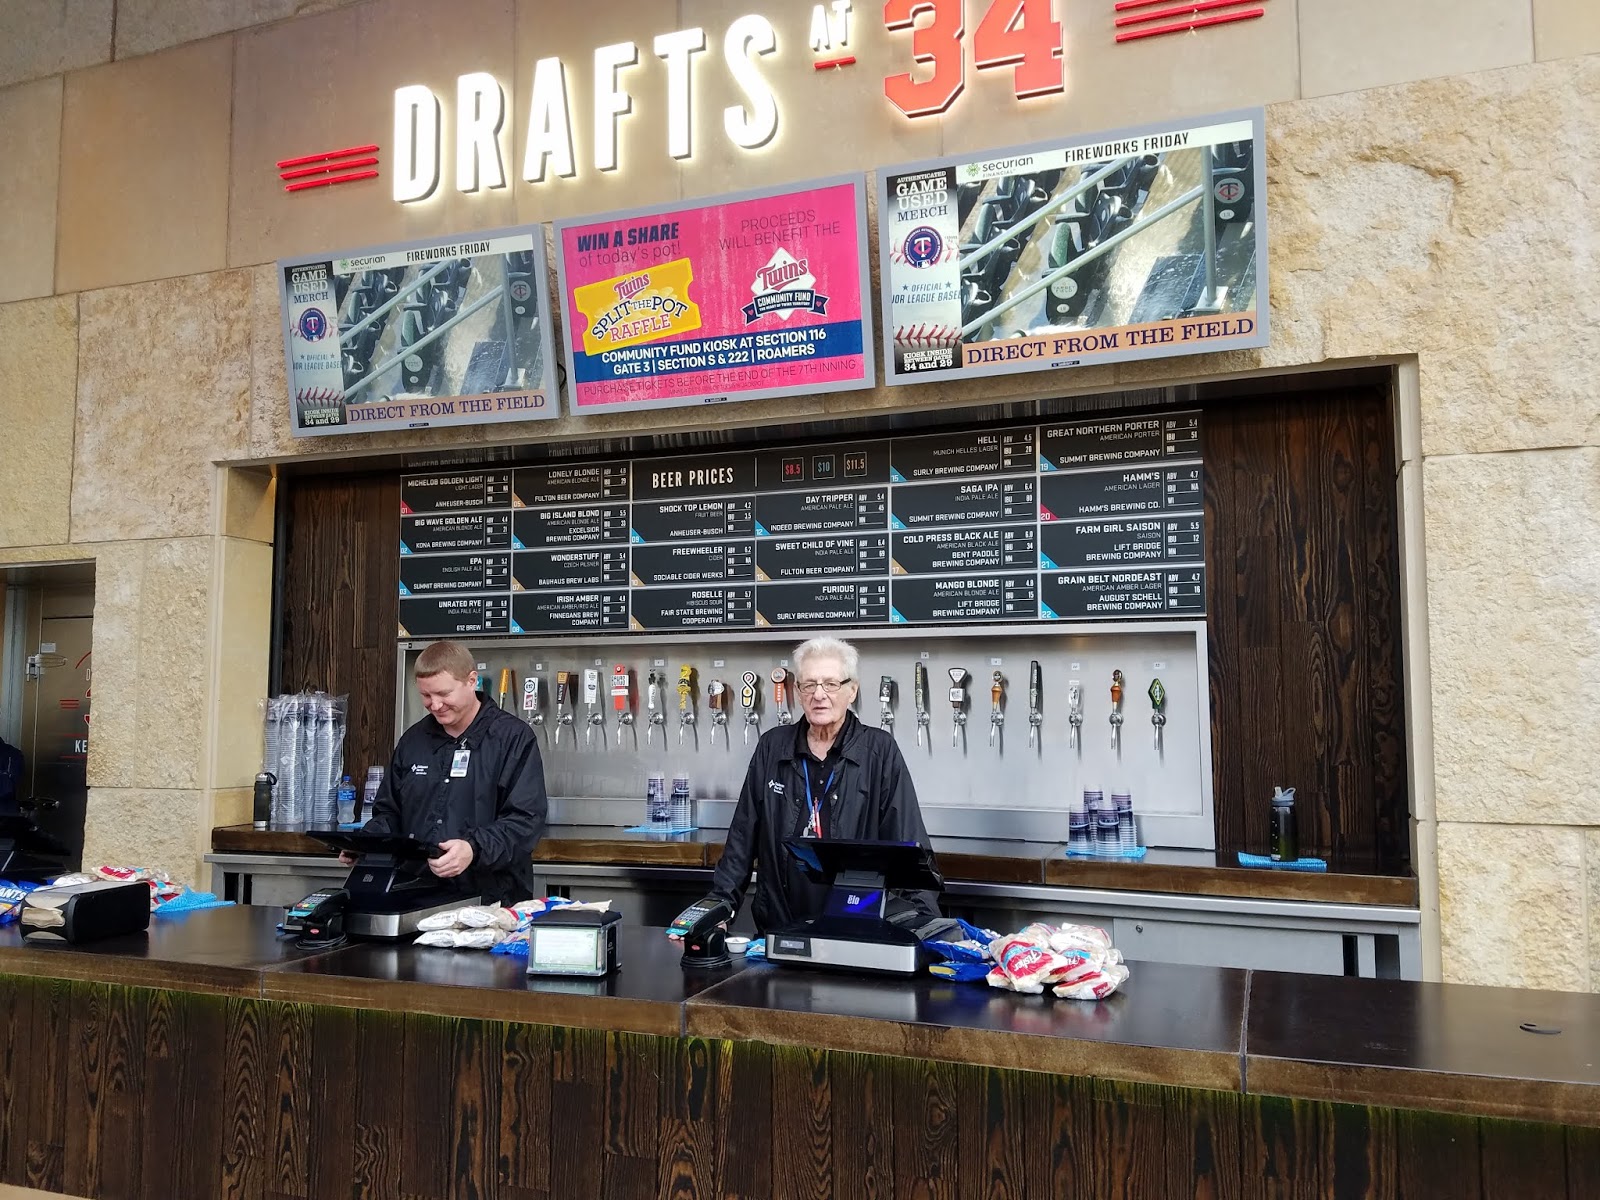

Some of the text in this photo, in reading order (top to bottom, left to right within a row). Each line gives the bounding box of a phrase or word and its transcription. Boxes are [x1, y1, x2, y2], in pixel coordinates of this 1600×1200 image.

[393, 0, 1064, 205] DRAFTS AT 34
[1065, 132, 1190, 163] FIREWORKS FRIDAY
[982, 157, 1034, 172] securian
[897, 171, 946, 184] AUTHENTICATED
[896, 177, 947, 197] GAME
[897, 192, 948, 211] USED
[898, 205, 948, 222] MERCH
[741, 210, 815, 232] PROCEEDS
[577, 222, 679, 252] WIN A SHARE
[719, 221, 840, 250] WILL BENEFIT THE
[406, 242, 491, 262] FIREWORKS FRIDAY
[580, 240, 680, 267] of today's pot!
[350, 255, 386, 266] securian
[292, 269, 327, 284] GAME
[757, 260, 807, 291] Twins
[292, 280, 328, 294] USED
[614, 274, 650, 300] Twins
[912, 283, 942, 292] OFFICIAL
[293, 292, 329, 304] MERCH
[757, 293, 793, 307] COMMUNITY
[795, 292, 810, 301] FUND
[907, 292, 936, 303] LEAGUE
[592, 296, 688, 339] SPLIT THE POT
[610, 313, 670, 341] RAFFLE
[602, 328, 826, 363] COMMUNITY FUND KIOSK AT SECTION 116
[967, 318, 1254, 364] DIRECT FROM THE FIELD
[614, 344, 815, 375] GATE 3 SECTION S & 222 ROAMERS
[904, 359, 953, 371] 34 and 29
[584, 383, 635, 395] PURCHASE
[636, 379, 675, 391] TICKETS
[677, 375, 715, 386] BEFORE
[717, 373, 735, 383] THE
[738, 370, 758, 381] END
[761, 369, 773, 379] OF
[777, 367, 795, 377] THE
[799, 364, 816, 374] 7TH
[819, 359, 856, 372] INNING
[349, 406, 405, 421] DIRECT
[410, 402, 455, 417] FROM
[459, 399, 492, 413] THE
[497, 395, 545, 409] FIELD
[1047, 421, 1159, 438] GREAT NORTHERN PORTER
[978, 436, 998, 444] HELL
[1060, 449, 1160, 464] SUMMIT BREWING COMPANY
[785, 464, 800, 475] $8.5
[818, 461, 830, 472] $10
[846, 459, 865, 470] $11.5
[549, 468, 599, 478] LONELY BLONDE
[652, 467, 733, 489] BEER PRICES
[1123, 472, 1160, 482] HAMM'S
[407, 479, 438, 487] MICHELOB
[440, 477, 464, 485] GOLDEN
[960, 484, 998, 494] SAGA IPA
[822, 493, 853, 502] TRIPPER
[659, 505, 682, 513] SHOCK
[1079, 501, 1160, 513] HAMM'S BREWING CO.
[1076, 522, 1161, 534] FARM GIRL SAISON
[904, 531, 999, 543] COLD PRESS BLACK ALE
[672, 546, 723, 556] FREEWHEELER
[775, 539, 854, 551] SWEET CHILD OF VINE
[1133, 542, 1161, 550] BRIDGE
[551, 553, 599, 561] WONDERSTUFF
[1086, 551, 1162, 561] BREWING COMPANY
[1058, 573, 1162, 584] GRAIN BELT NORDEAST
[822, 585, 854, 593] FURIOUS
[936, 580, 999, 590] MANGO BLONDE
[1082, 584, 1114, 592] AMERICAN
[692, 590, 723, 598] ROSELLE
[1099, 593, 1163, 602] AUGUST SCHELL
[439, 600, 467, 608] UNRATED
[1087, 601, 1163, 611] BREWING COMPANY
